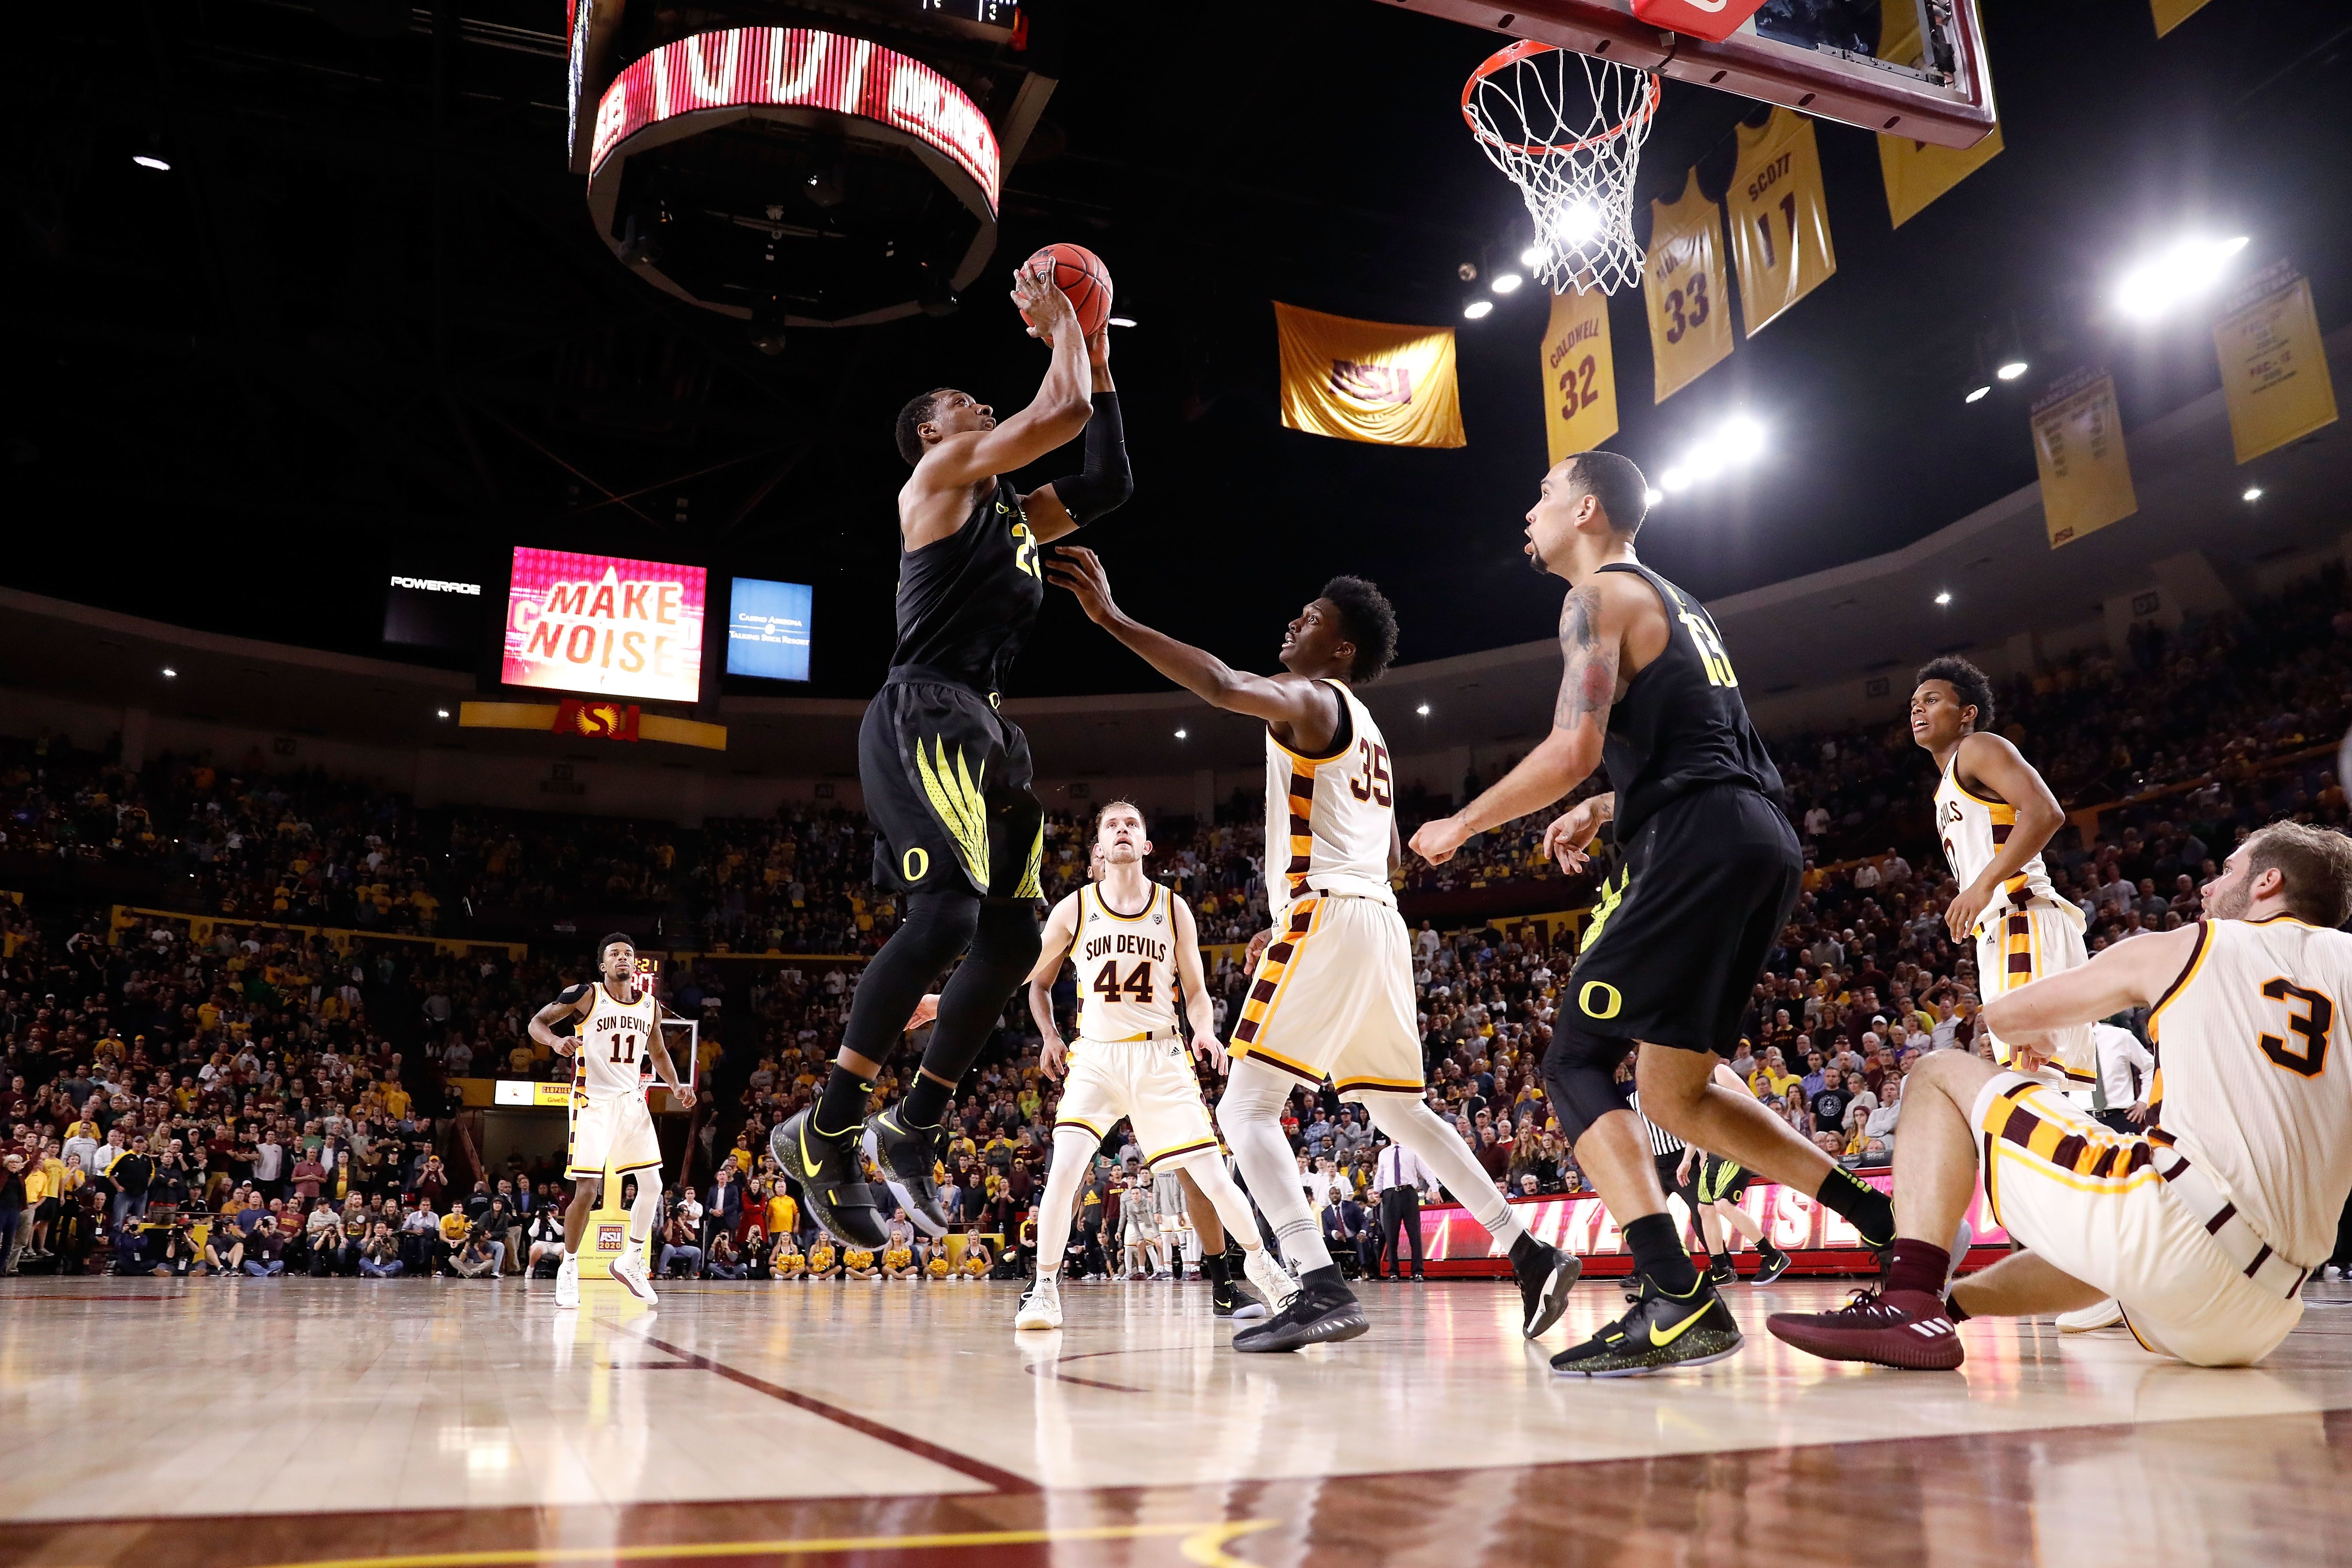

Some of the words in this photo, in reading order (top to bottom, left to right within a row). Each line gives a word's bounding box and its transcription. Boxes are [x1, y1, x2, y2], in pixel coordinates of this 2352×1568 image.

[1748, 152, 1792, 202] SCOTT
[1664, 271, 1710, 344] 33
[1550, 317, 1599, 369] CALDWELL
[1560, 354, 1599, 421] 32
[391, 576, 481, 595] POWERADE
[547, 584, 678, 625] MAKE
[527, 621, 678, 678] NOISE
[552, 699, 640, 742] ASU
[1350, 737, 1392, 809] 35
[1938, 800, 1963, 839] EVILS
[903, 847, 929, 881] O
[1086, 934, 1111, 961] SUN
[1117, 934, 1166, 962] DEVILS
[1093, 959, 1154, 1004] 44
[1579, 981, 1622, 1019] O
[597, 1016, 617, 1032] SUN
[620, 1016, 651, 1037] DEVILS
[2257, 976, 2336, 1080] 3
[610, 1033, 635, 1064] 11
[599, 1232, 621, 1242] ASU
